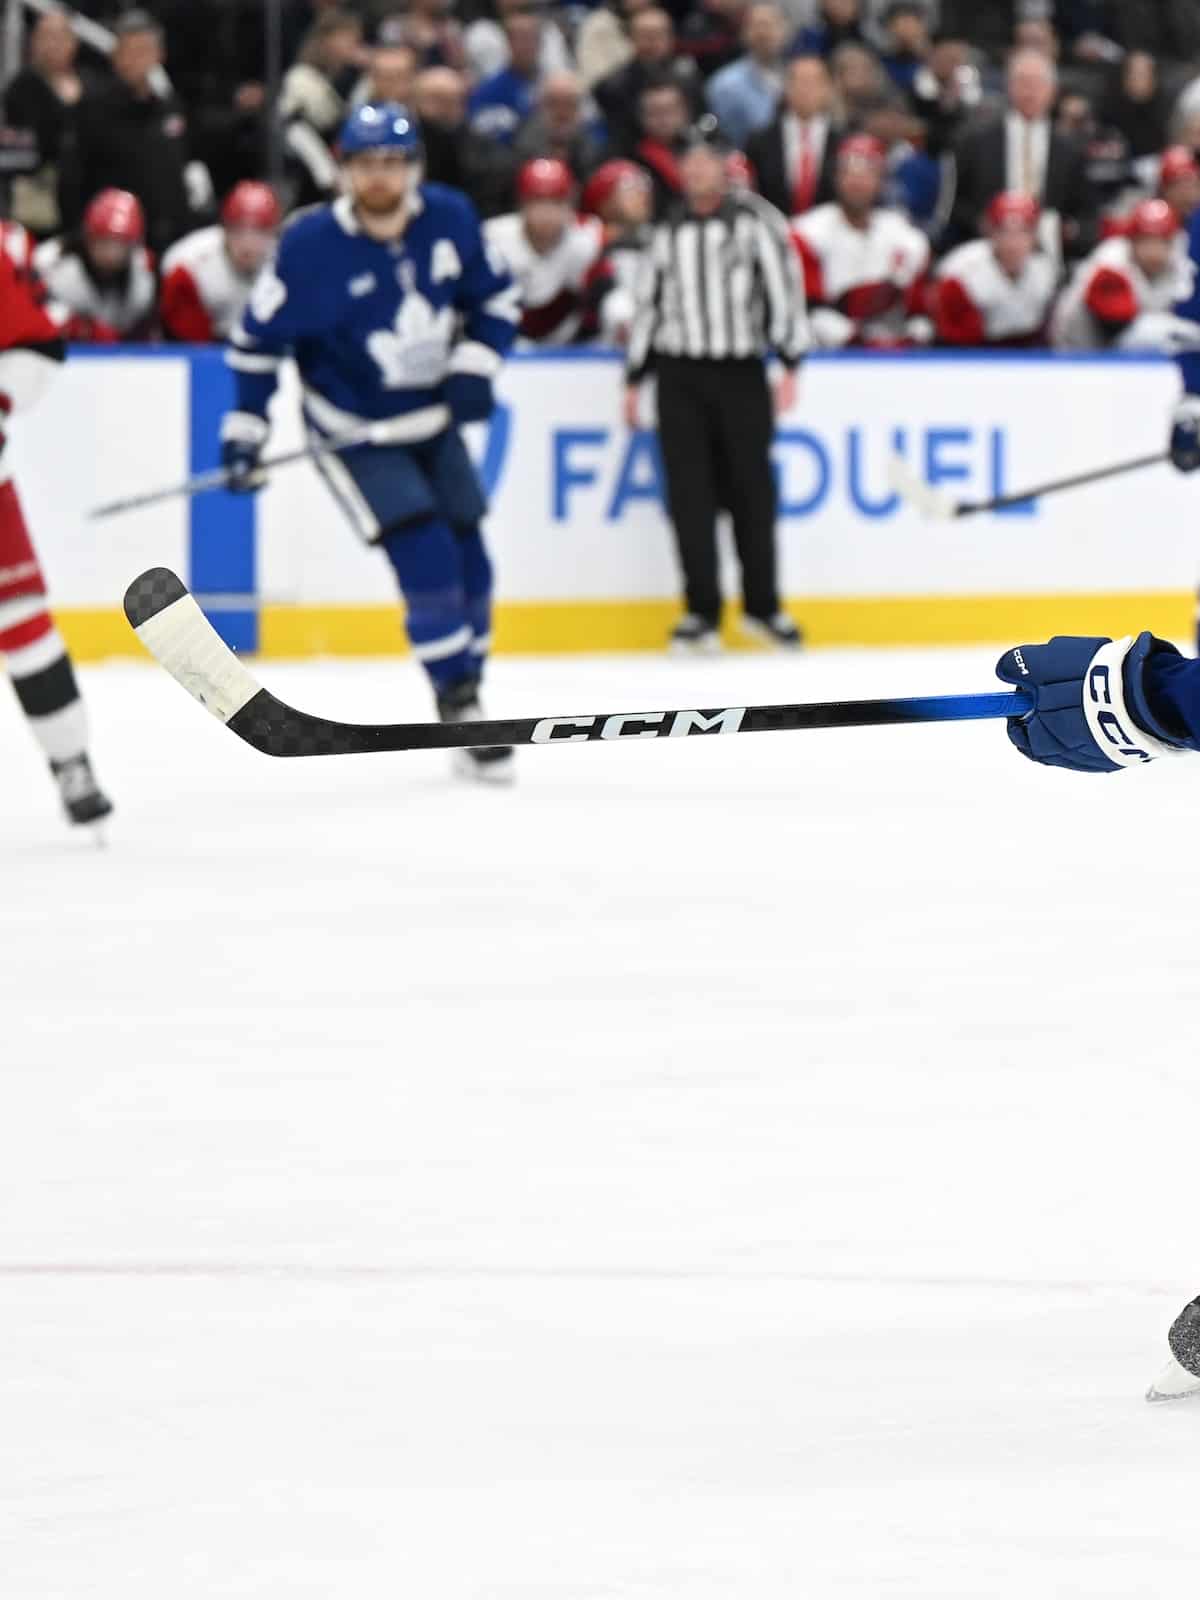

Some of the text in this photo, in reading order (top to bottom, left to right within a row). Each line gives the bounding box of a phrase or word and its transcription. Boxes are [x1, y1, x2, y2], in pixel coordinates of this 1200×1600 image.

[551, 427, 1038, 522] FADUEL
[1012, 649, 1030, 675] CCM
[529, 707, 747, 744] CCM
